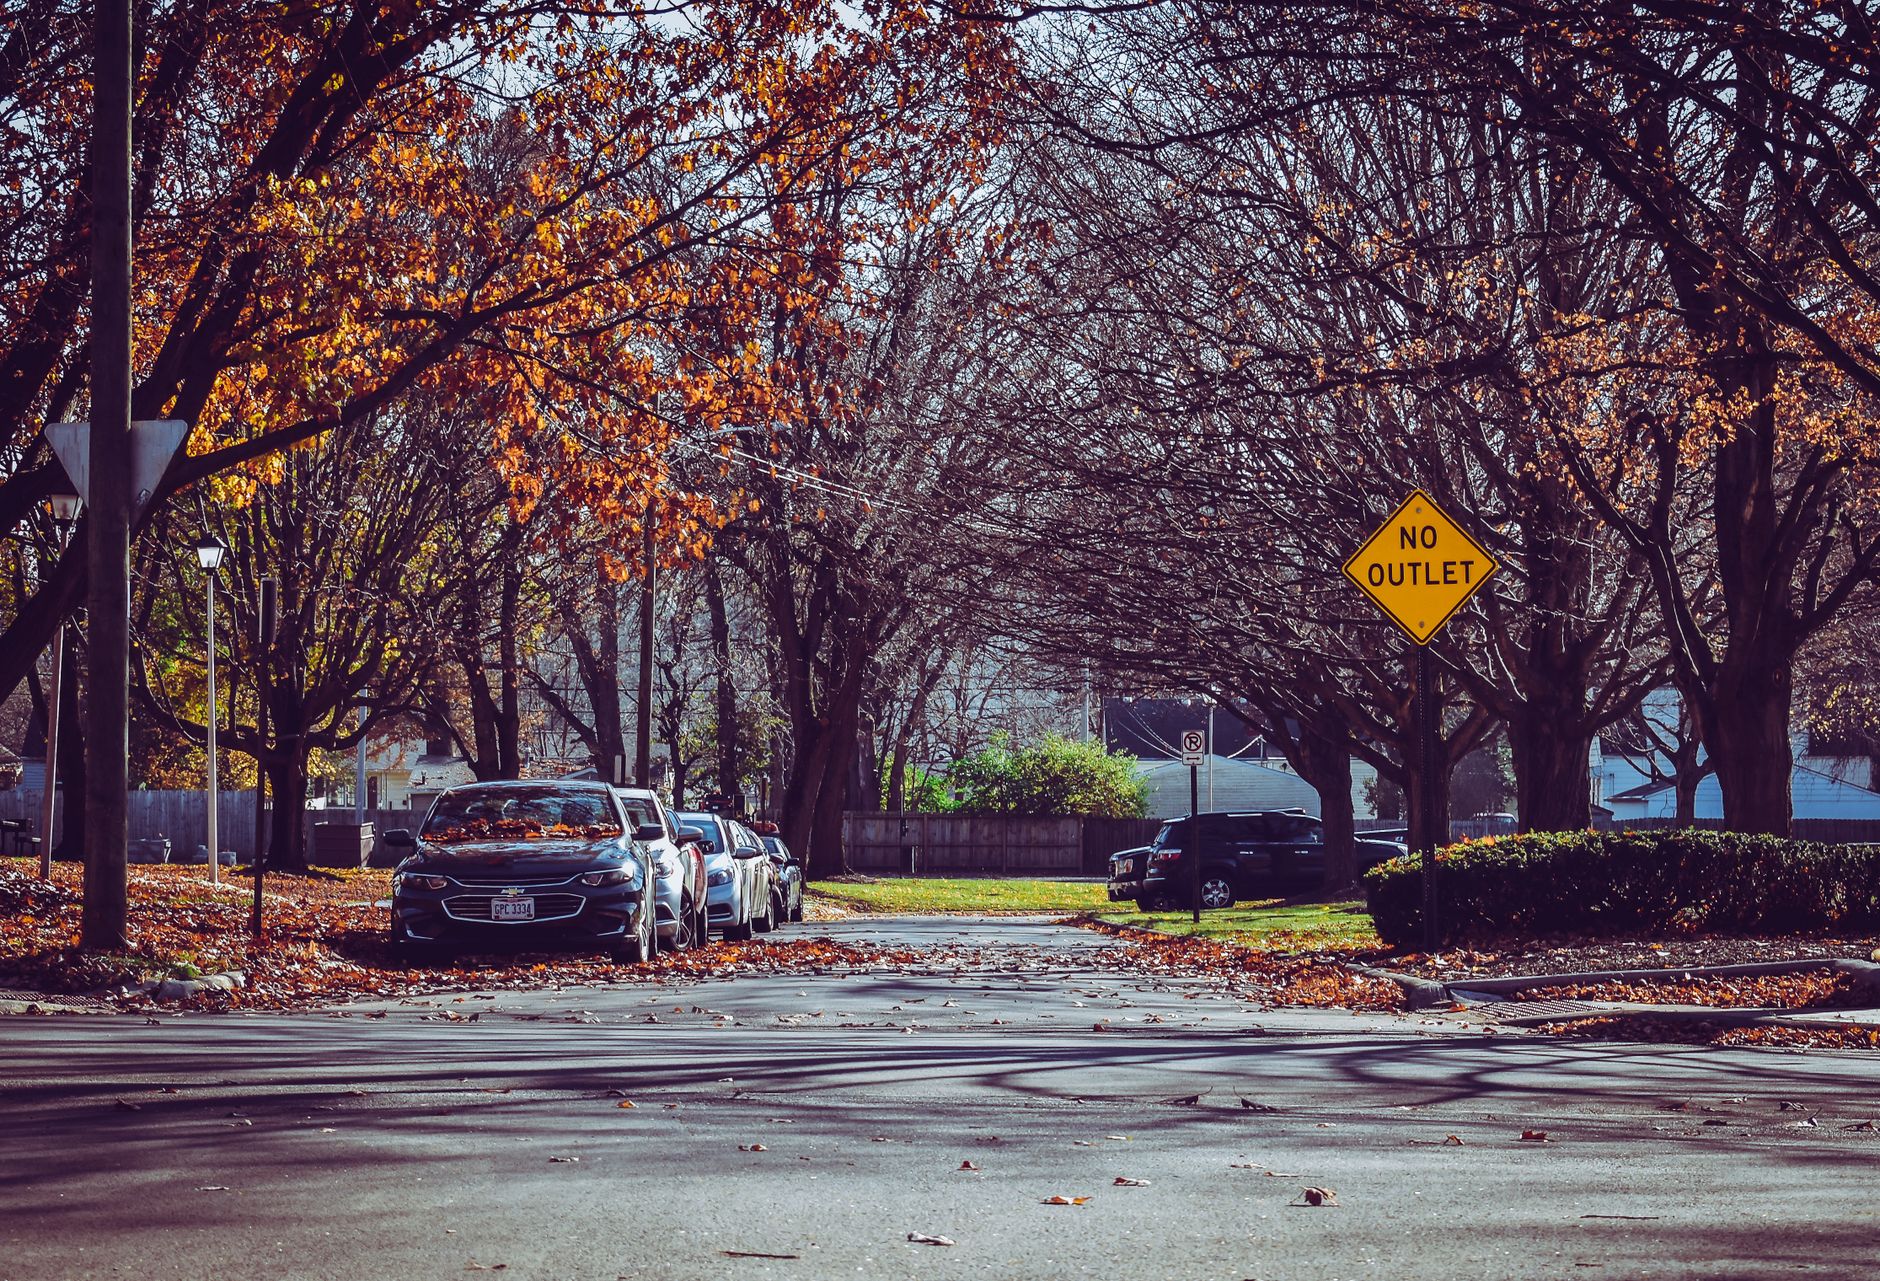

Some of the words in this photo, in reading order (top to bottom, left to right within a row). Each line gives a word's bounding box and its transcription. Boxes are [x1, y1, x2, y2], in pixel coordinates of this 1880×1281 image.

[1400, 525, 1437, 550] NO
[1368, 561, 1474, 587] OUTLET
[494, 903, 510, 915] GPC
[511, 903, 531, 915] 3334
